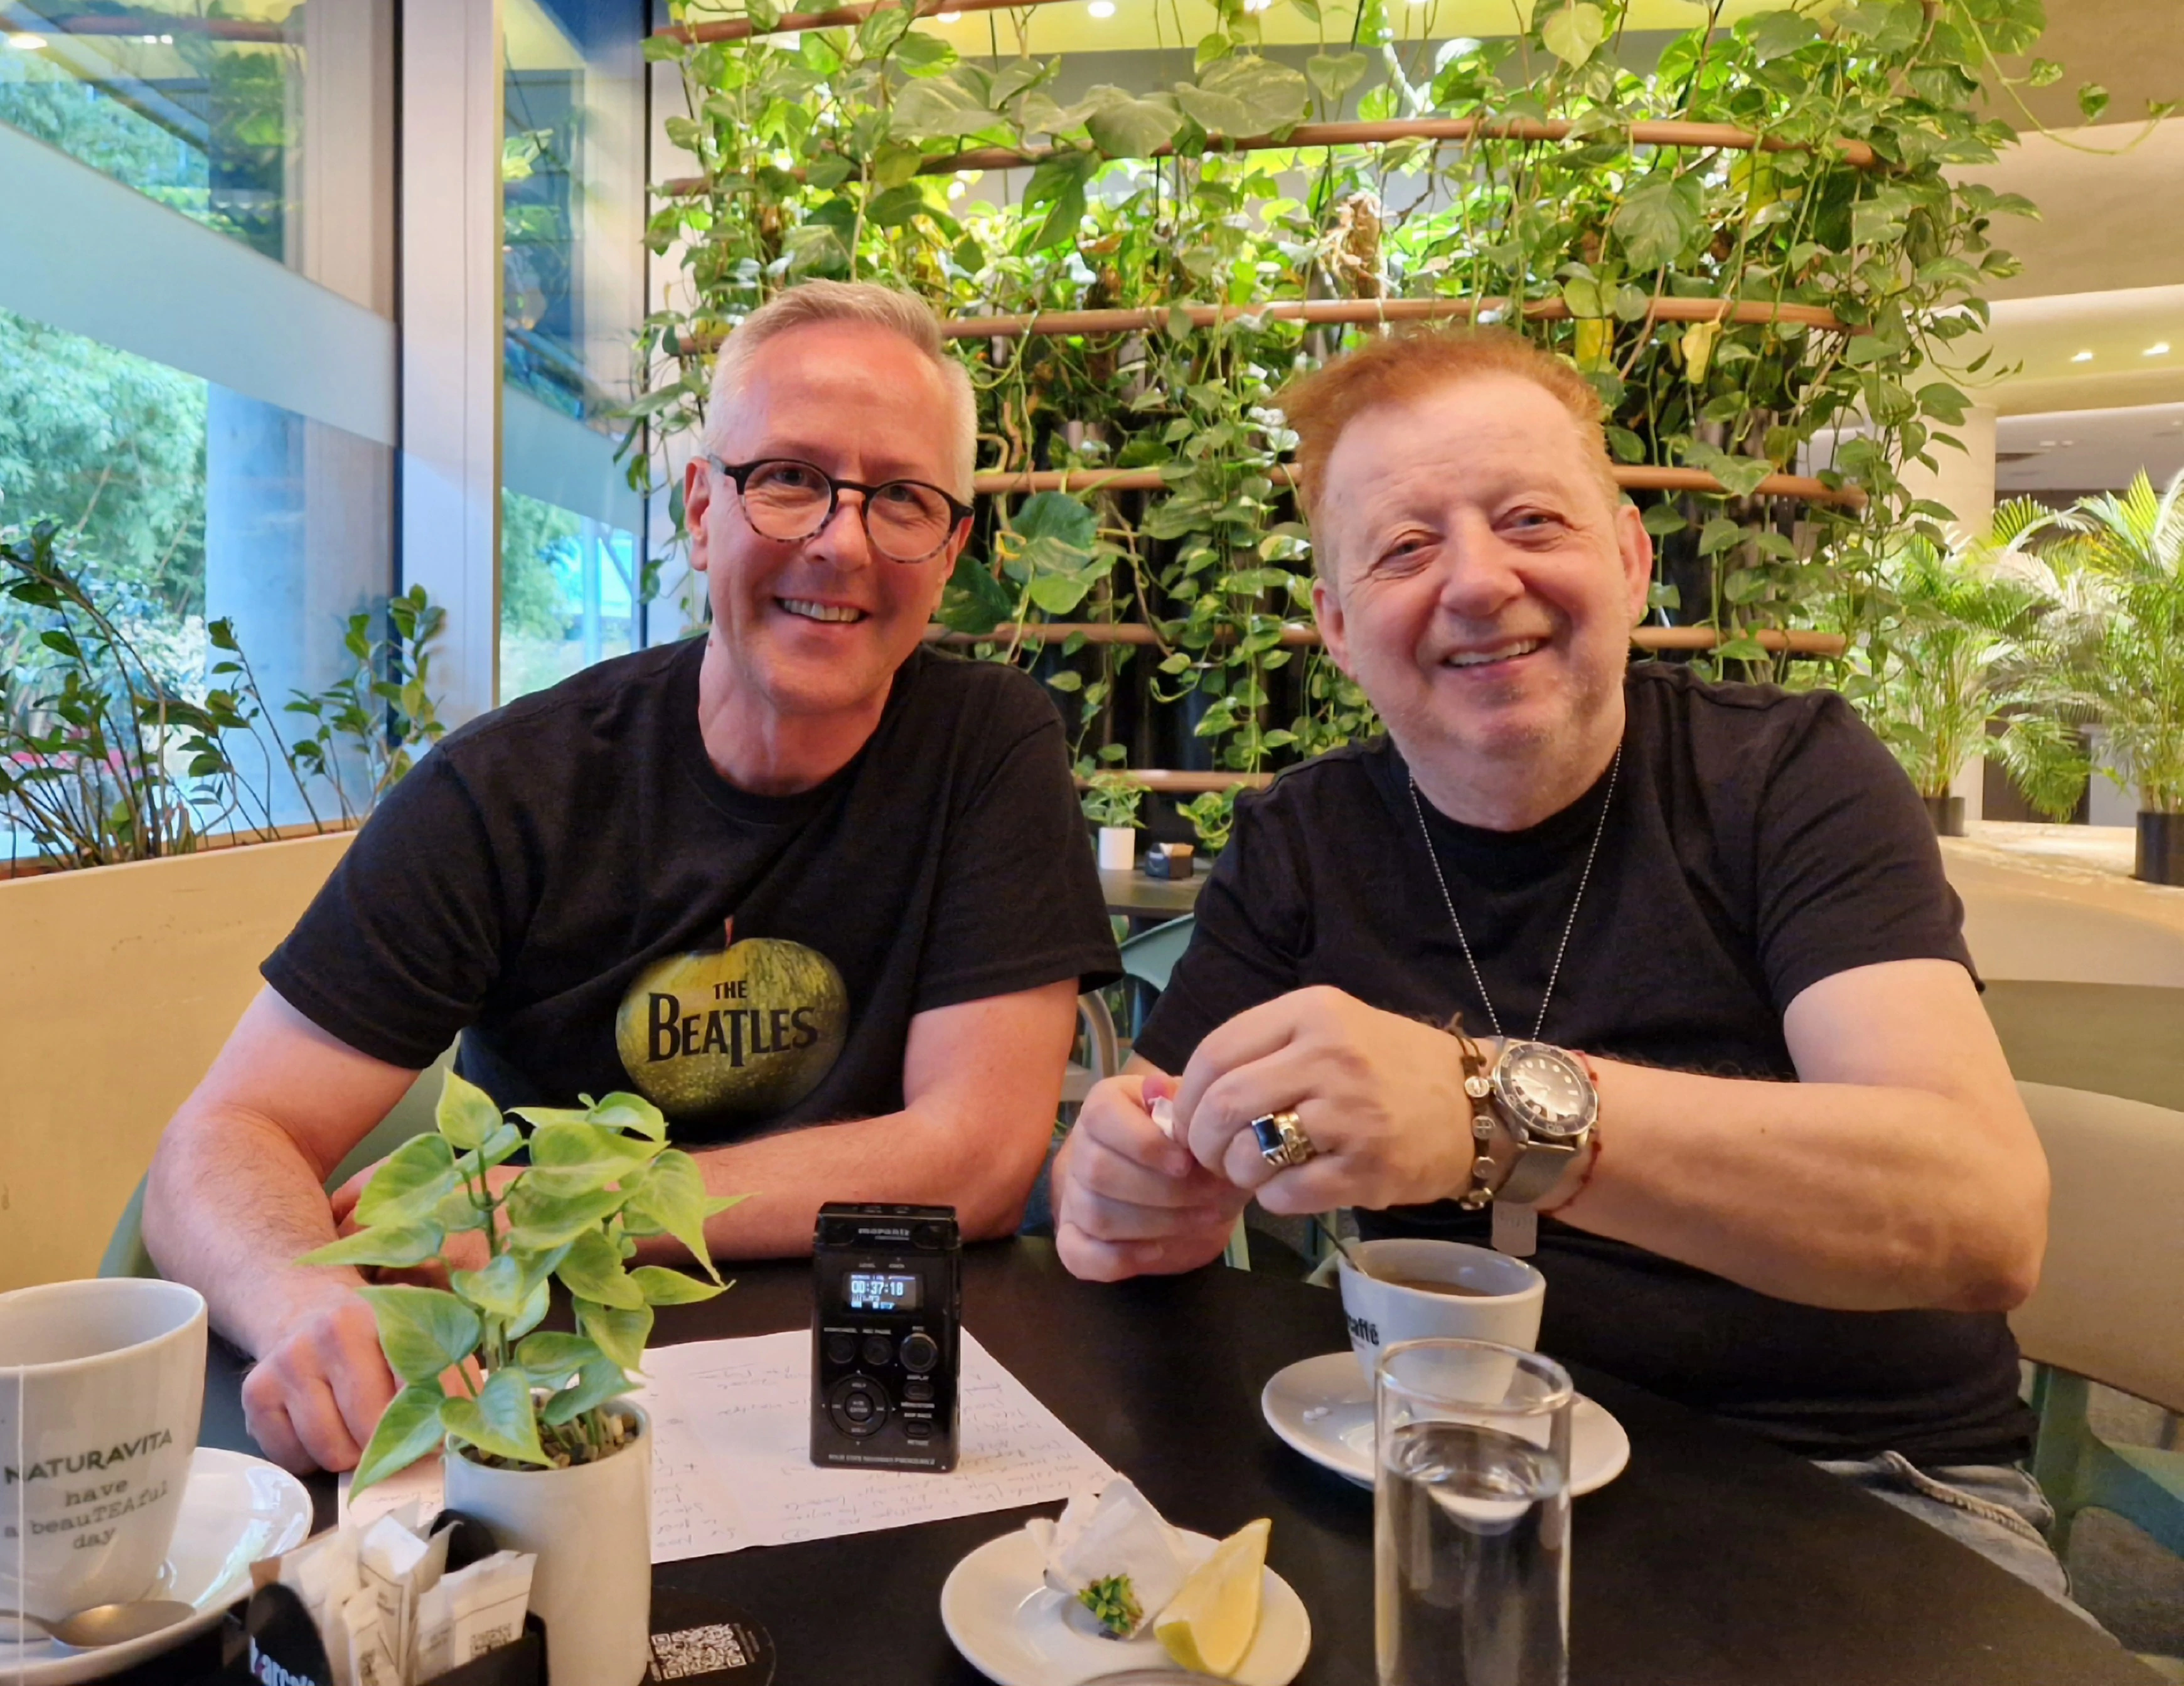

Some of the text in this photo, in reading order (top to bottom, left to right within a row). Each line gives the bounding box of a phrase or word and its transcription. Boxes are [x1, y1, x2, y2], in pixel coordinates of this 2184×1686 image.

[712, 980, 747, 1000] THE
[646, 992, 818, 1068] BEATLES
[4, 1428, 173, 1485] NATURAVITA
[65, 1480, 129, 1507] have
[4, 1525, 19, 1537] a
[72, 1527, 117, 1549] day
